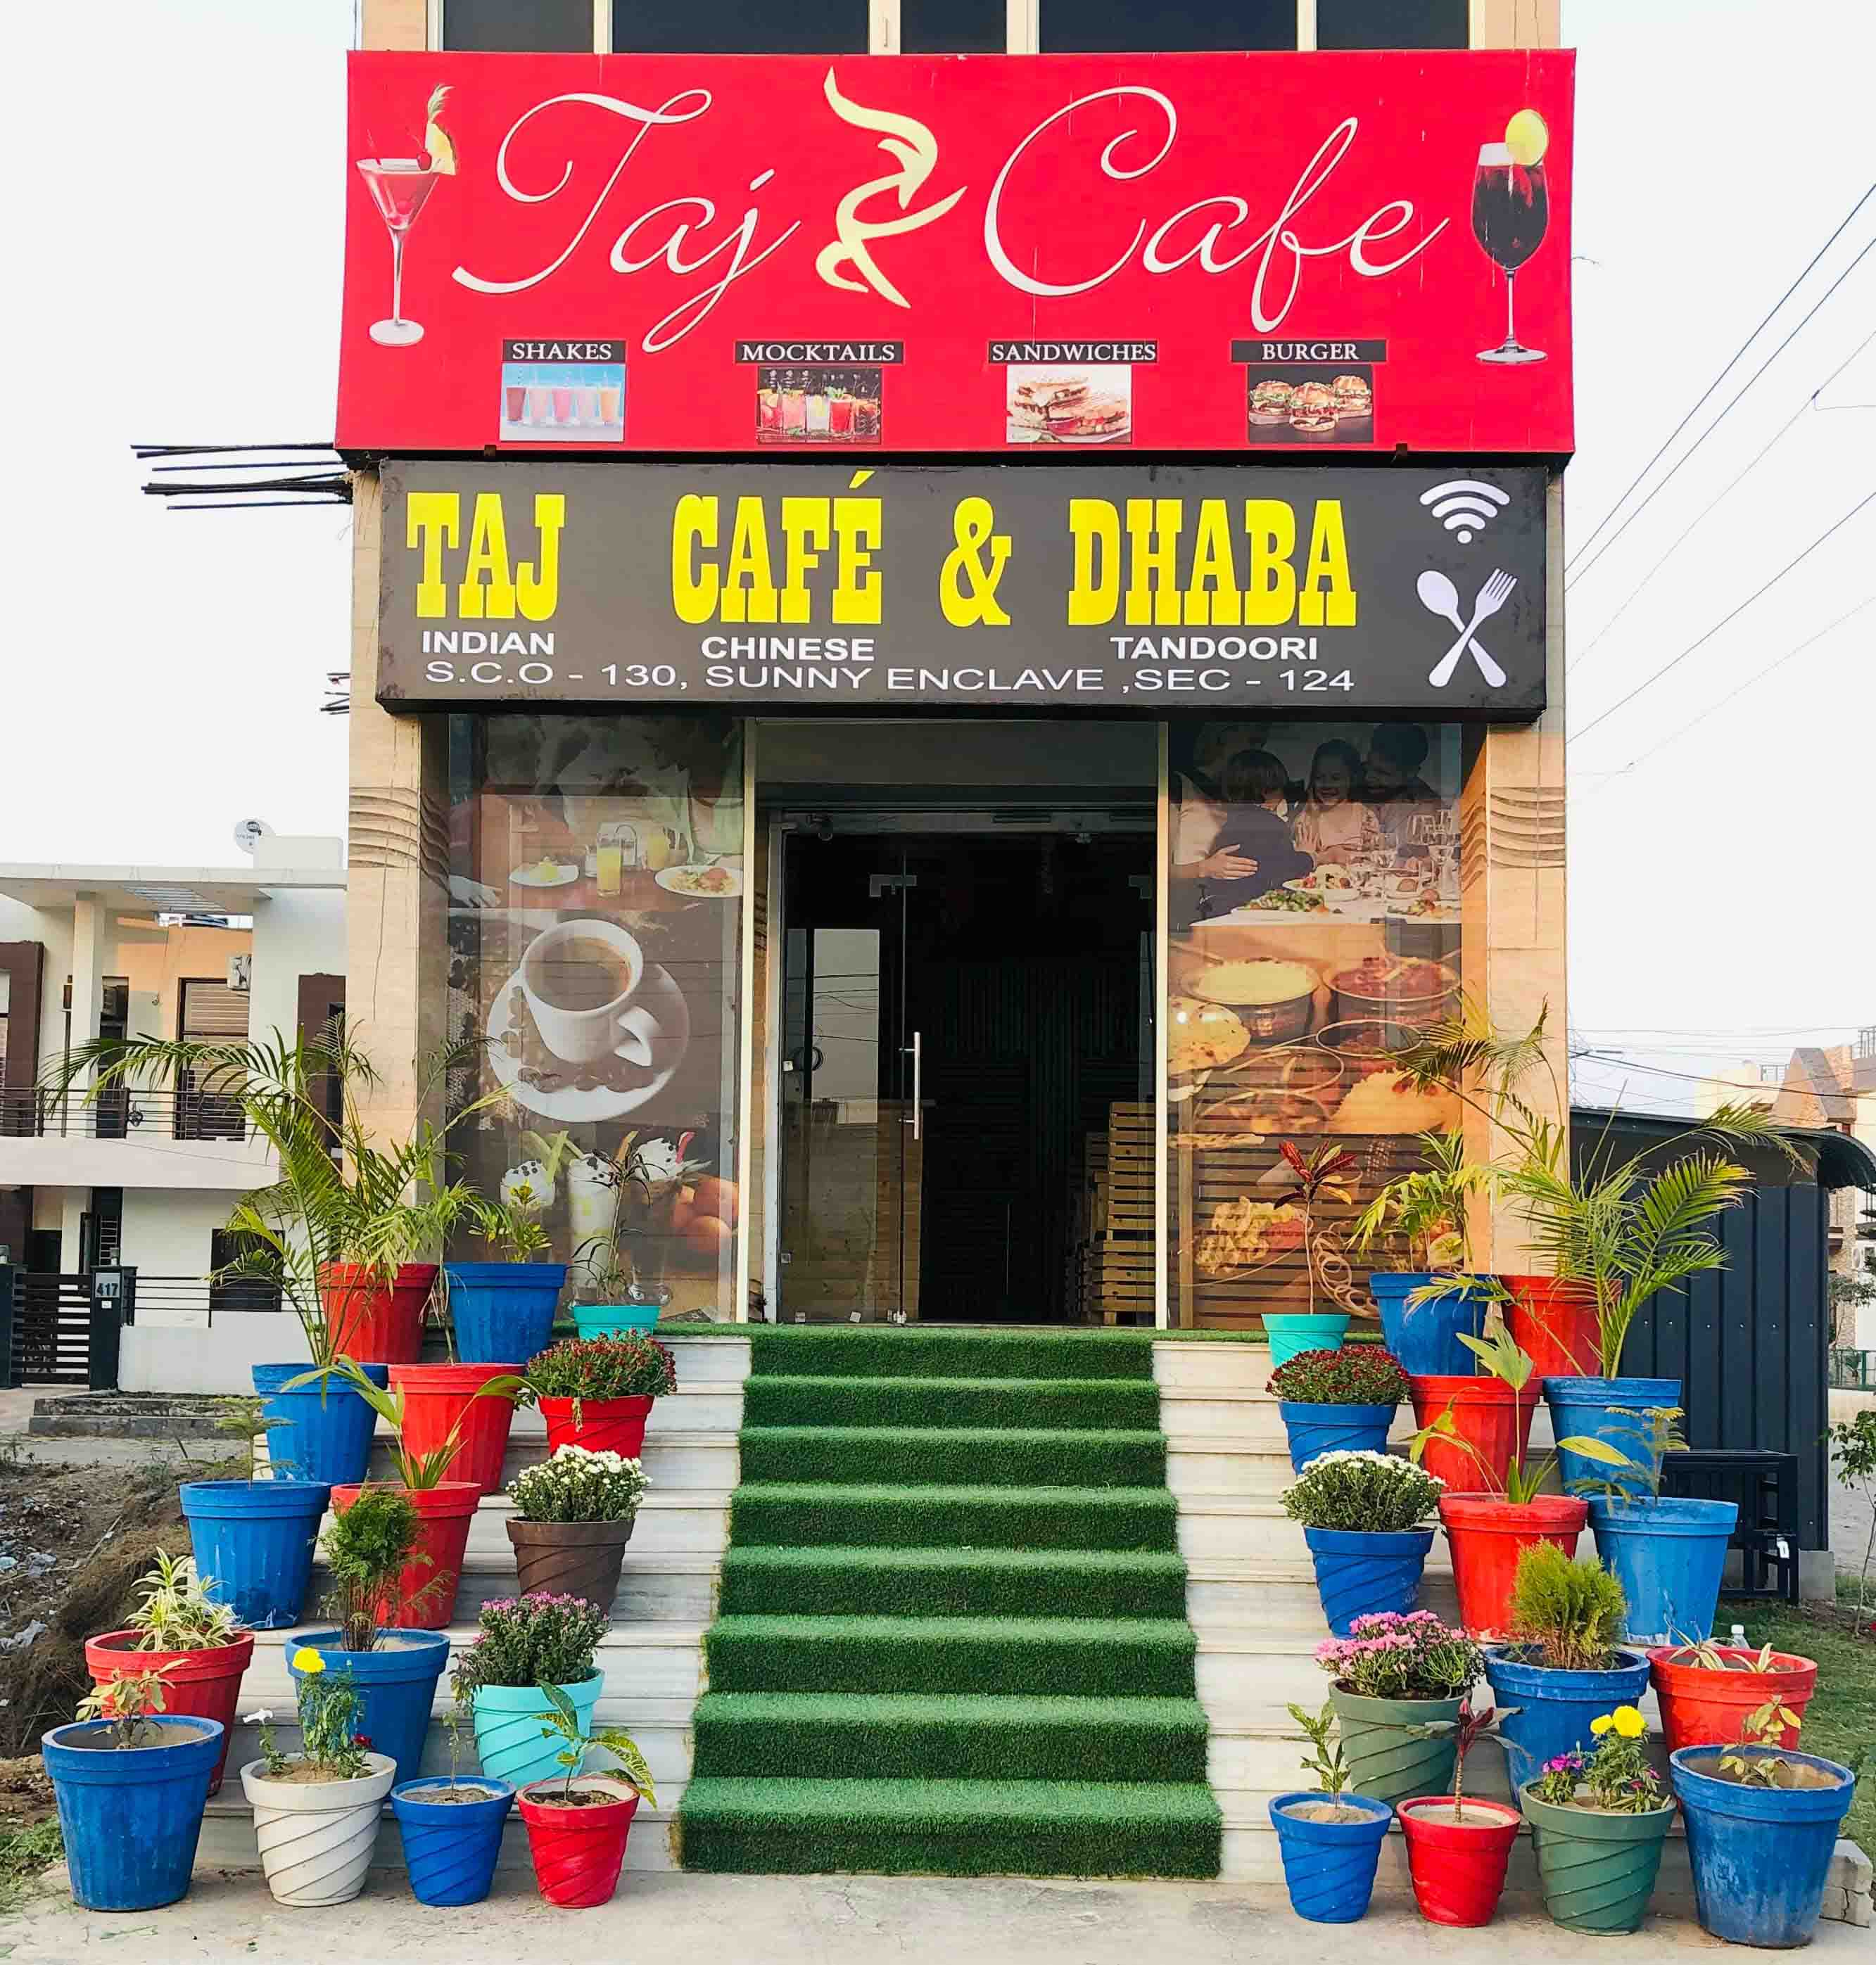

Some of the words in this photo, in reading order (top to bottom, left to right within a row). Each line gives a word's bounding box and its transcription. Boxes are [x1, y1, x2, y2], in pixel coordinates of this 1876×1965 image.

[451, 89, 801, 354] Taj
[984, 85, 1450, 333] Cafe
[512, 343, 611, 360] SHAKES
[742, 343, 895, 362] MOCKTAILS
[991, 343, 1156, 362] SANDWICHES
[1262, 343, 1359, 361] BURGER
[407, 492, 566, 622] TAJ
[671, 470, 882, 625] CAFÉ
[939, 497, 1012, 627] &
[1068, 499, 1357, 626] DHABA
[422, 630, 555, 656] INDIAN
[701, 636, 875, 661] CHINESE
[1110, 637, 1318, 660] TANDOORI
[425, 661, 554, 684] S.C.O
[601, 663, 688, 690] 130,
[705, 666, 873, 689] SUNNY
[887, 667, 1105, 691] ENCLAVE
[1279, 669, 1355, 692] 124
[96, 1283, 118, 1297] 417
